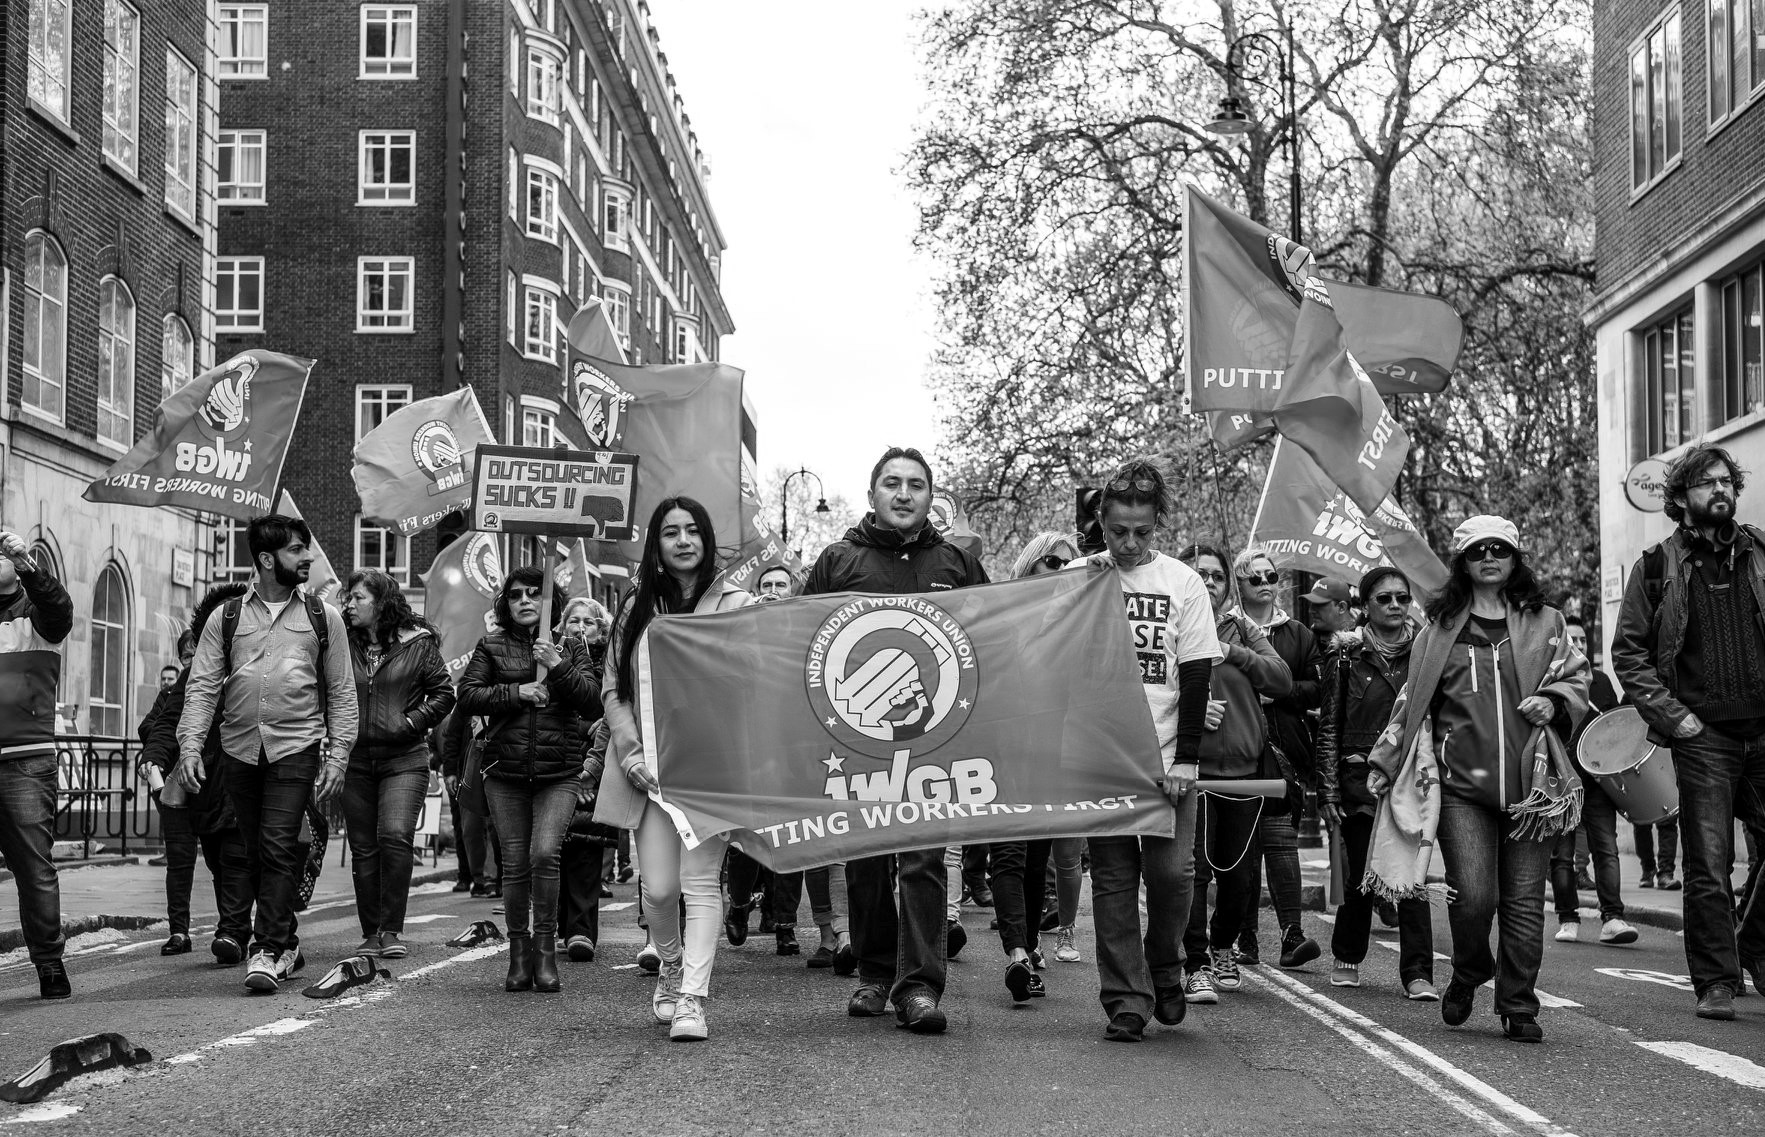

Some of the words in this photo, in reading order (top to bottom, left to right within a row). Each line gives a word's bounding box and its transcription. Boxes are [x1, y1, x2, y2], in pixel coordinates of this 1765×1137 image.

[1203, 367, 1285, 390] PUTTI
[487, 460, 626, 485] OUTSOURCING
[484, 484, 558, 509] SUCKS
[1316, 543, 1375, 574] WORK
[1126, 596, 1168, 619] ATE
[808, 600, 865, 688] INDEPENDENT
[867, 597, 943, 623] WORKERS
[941, 619, 975, 670] UNION
[1134, 624, 1167, 650] SE
[1139, 660, 1165, 677] SE!
[753, 811, 850, 849] TING
